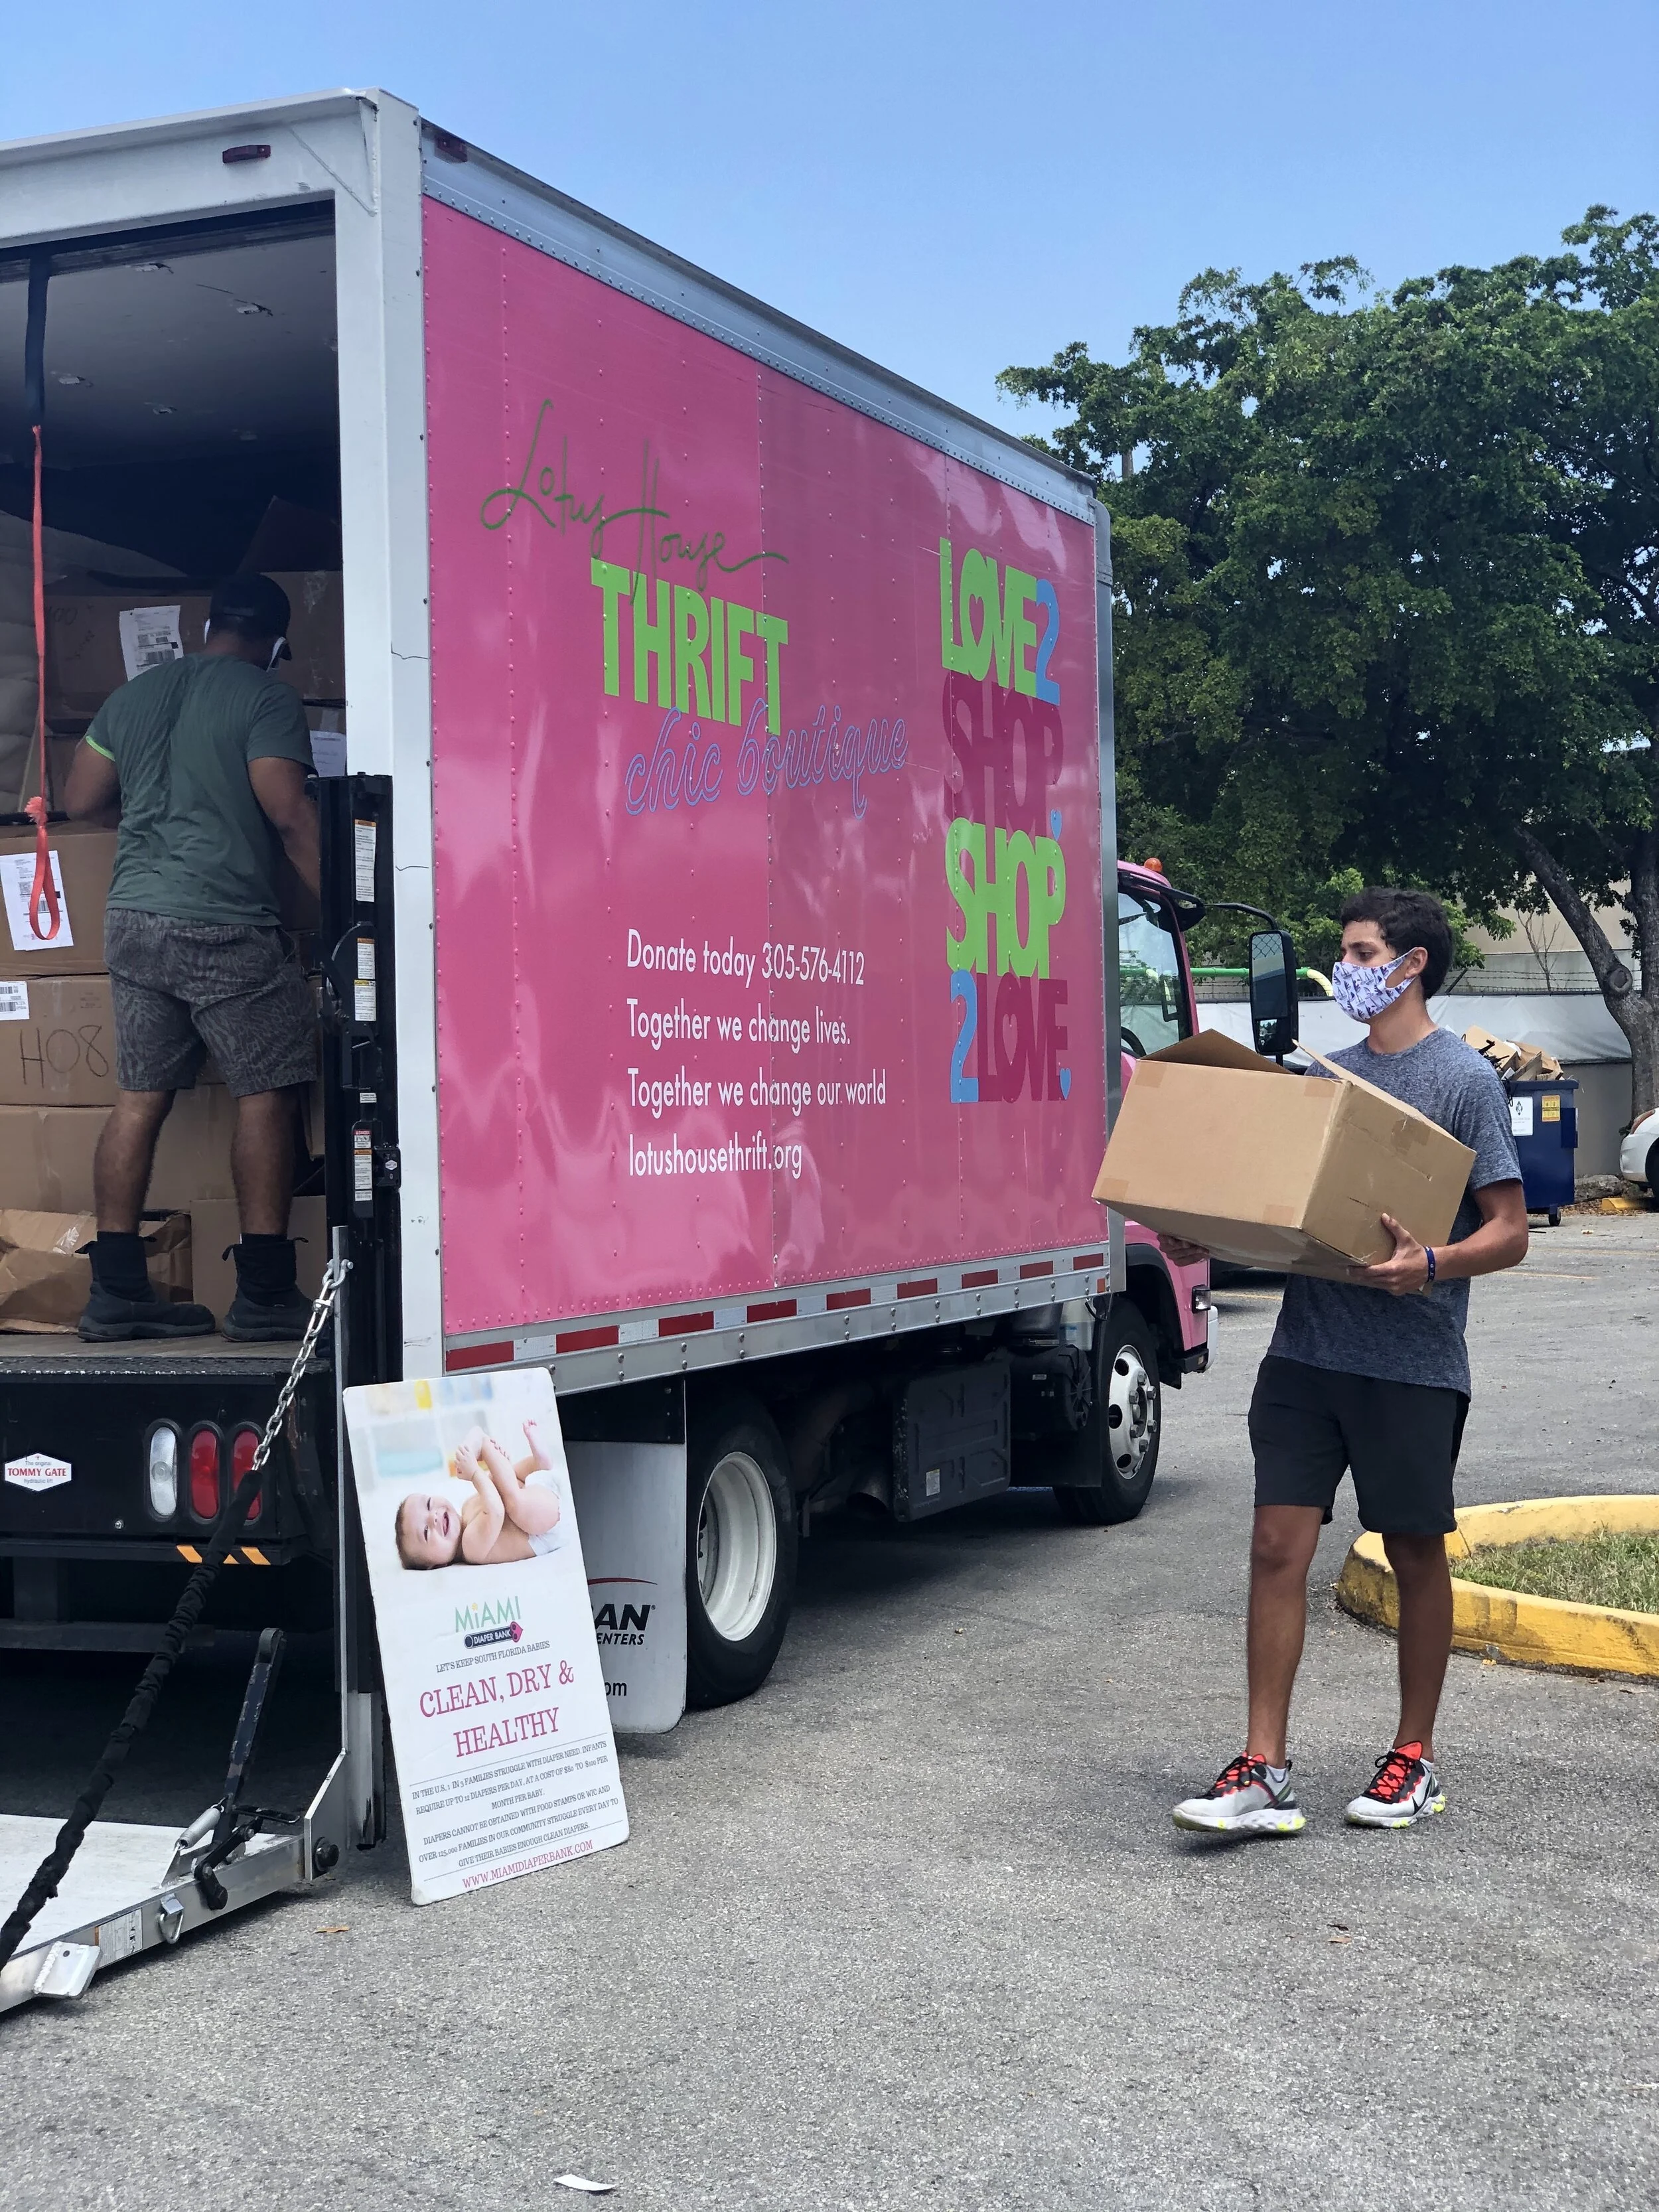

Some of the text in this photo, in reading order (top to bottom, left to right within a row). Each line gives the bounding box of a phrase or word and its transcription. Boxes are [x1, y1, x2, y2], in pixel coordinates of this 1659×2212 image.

[480, 398, 607, 559] Lotus
[591, 557, 788, 736] THRIFT
[624, 697, 908, 820] chic boutique
[946, 817, 1066, 980] SHOP
[627, 928, 865, 988] Donate today 305-576-4112
[627, 998, 850, 1054] Together we change lives.
[628, 1065, 887, 1119] Together we change our world
[630, 1130, 802, 1179] lotushousethrift.org
[7, 1468, 67, 1477] TOMMY GATE
[436, 1641, 550, 1673] LET'S KEEP SOUTH FLORIDA BABIES
[474, 1629, 512, 1645] DIAPER BANK
[596, 1633, 644, 1645] ENTERS
[420, 1660, 574, 1717] CLEAN, DRY &
[453, 1707, 559, 1757] HEALTHY
[412, 1791, 420, 1800] IN
[420, 1787, 435, 1797] THE
[451, 1780, 460, 1789] IN
[465, 1771, 494, 1786] FAMILIES
[494, 1763, 526, 1777] STRUGGLE
[526, 1757, 542, 1768] WITH
[543, 1752, 565, 1764] DIAPER
[581, 1740, 607, 1753] INFANTS
[415, 1800, 445, 1815] REQUIRE
[446, 1797, 454, 1806] UP
[454, 1795, 464, 1805] TO
[470, 1786, 497, 1800] DIAPERS
[498, 1782, 510, 1793] PER
[526, 1775, 534, 1785] AT
[540, 1770, 555, 1781] COST
[555, 1767, 563, 1776] OF
[564, 1765, 573, 1774] $80
[597, 1755, 609, 1765] PER
[423, 1785, 611, 1846] DIAPERS CANNOT BE OBTAINED WITH FOOD STAMPS OR WIC AND
[491, 1788, 545, 1810] MONTH PER BABY.
[419, 1851, 438, 1863] OVER
[458, 1836, 488, 1851] FAMILIES
[496, 1830, 510, 1840] OUR
[510, 1818, 546, 1836] COMMUNITY
[547, 1809, 578, 1825] STRUGGLE
[578, 1805, 597, 1816] EVERY
[598, 1799, 610, 1810] DAY
[610, 1797, 618, 1806] TO
[459, 1856, 474, 1867] GIVE
[474, 1850, 494, 1862] THEIR
[494, 1844, 517, 1856] BABIES
[517, 1835, 543, 1850] ENOUGH
[543, 1830, 563, 1842] CLEAN
[462, 1839, 593, 1888] WWW.MIAMIDIAPERBANK.COM
